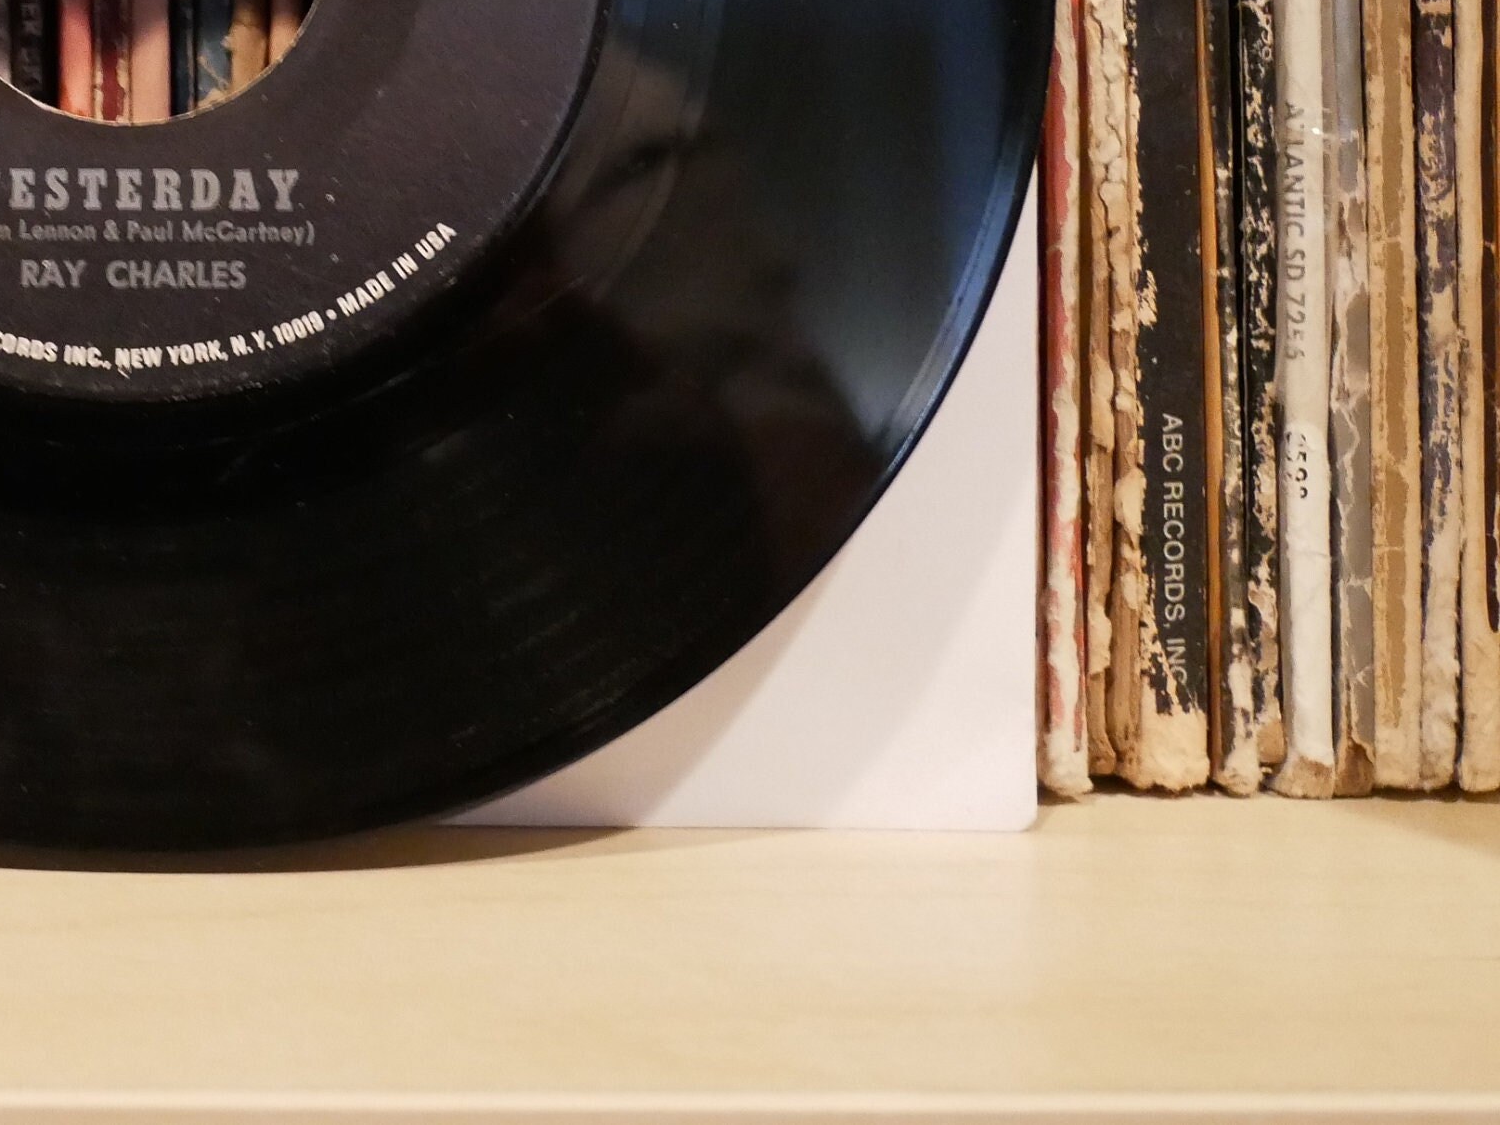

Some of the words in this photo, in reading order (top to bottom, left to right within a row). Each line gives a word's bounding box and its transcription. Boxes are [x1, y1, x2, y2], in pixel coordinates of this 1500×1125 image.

[18, 219, 98, 242] Lennon
[102, 218, 121, 242] &
[126, 219, 174, 242] Paul
[181, 219, 316, 246] McCartney)
[19, 258, 88, 290] RAY
[105, 259, 248, 290] CHARLES
[1284, 248, 1306, 282] SD
[114, 345, 163, 371] NEW
[272, 310, 325, 346] 10019
[336, 270, 397, 318] MADE
[391, 252, 420, 280] IN
[414, 222, 458, 261] USA
[1162, 413, 1184, 473] ABC
[1161, 481, 1186, 629] RECORDS,
